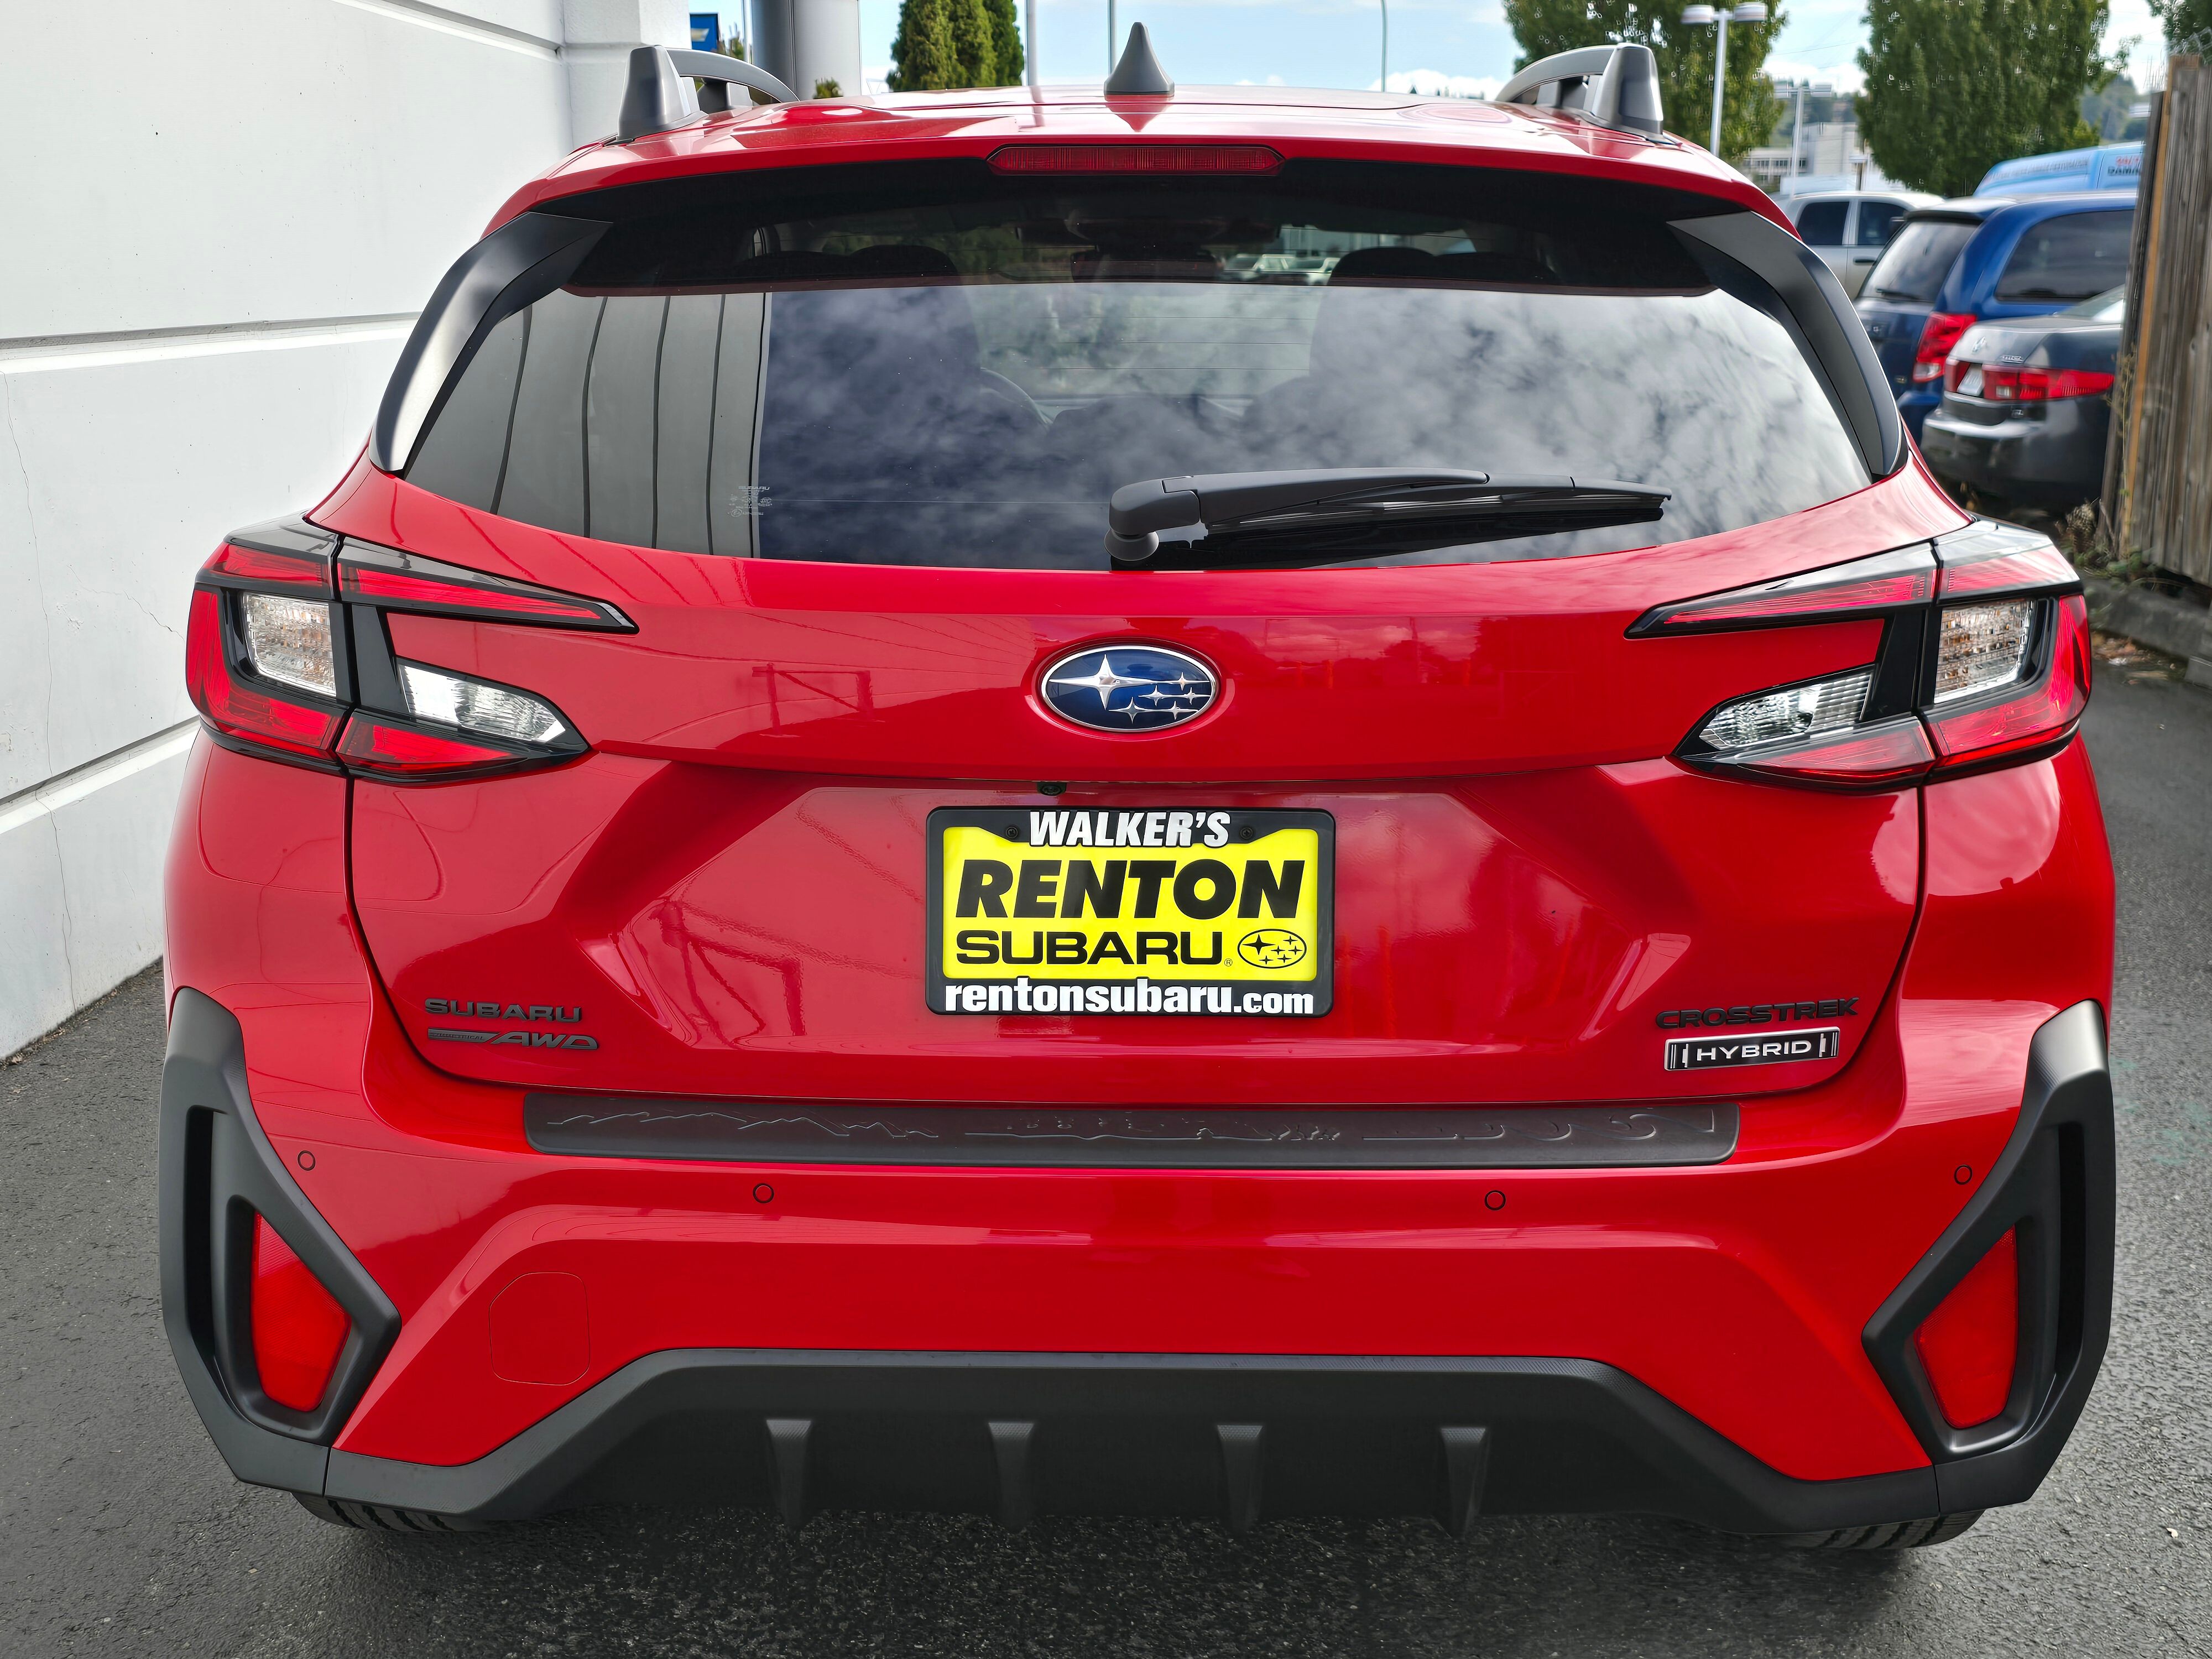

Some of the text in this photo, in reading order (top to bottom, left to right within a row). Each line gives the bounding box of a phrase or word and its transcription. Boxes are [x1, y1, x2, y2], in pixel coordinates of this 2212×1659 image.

[1029, 810, 1230, 848] WALKER'S
[956, 858, 1306, 920] RENTON
[956, 930, 1223, 965] SUBARU
[425, 998, 582, 1023] SUBARU
[944, 975, 1313, 1014] rentonsubaru.com
[1656, 997, 1860, 1029] CROSSTREK
[491, 1031, 599, 1050] AWD
[1697, 1040, 1812, 1061] HYBRID
